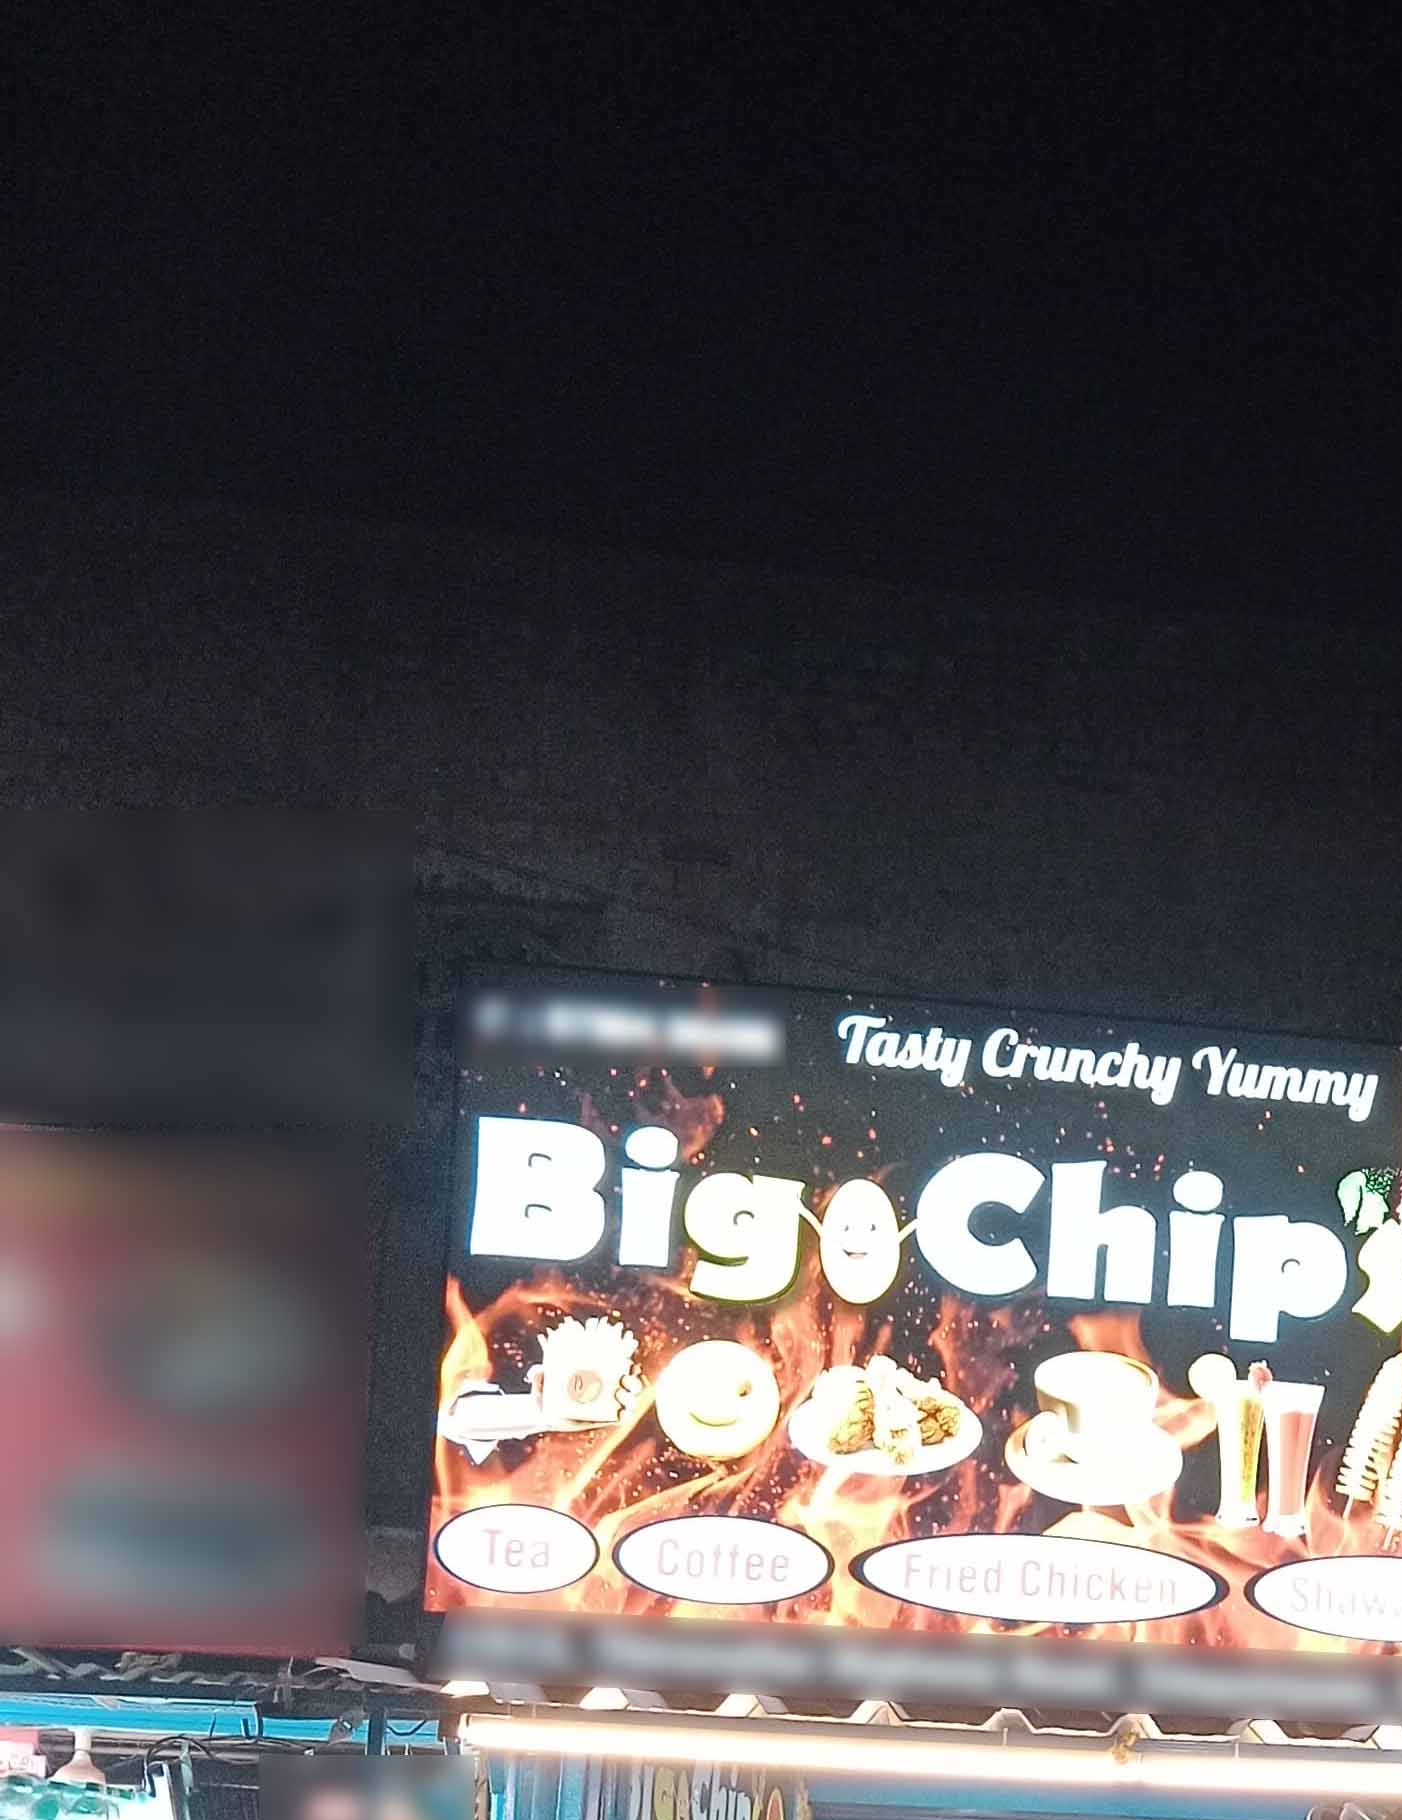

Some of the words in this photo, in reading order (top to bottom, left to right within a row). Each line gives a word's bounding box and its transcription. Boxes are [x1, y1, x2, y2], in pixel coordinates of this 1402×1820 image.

[837, 1014, 972, 1087] Tasty
[981, 1027, 1183, 1105] Crunchy
[1191, 1045, 1379, 1122] Yummy
[469, 1115, 806, 1303] Big
[480, 1527, 551, 1569] Tea
[656, 1538, 790, 1583] Coffee
[903, 1552, 1003, 1596] Fried
[1020, 1558, 1177, 1606] Chicken
